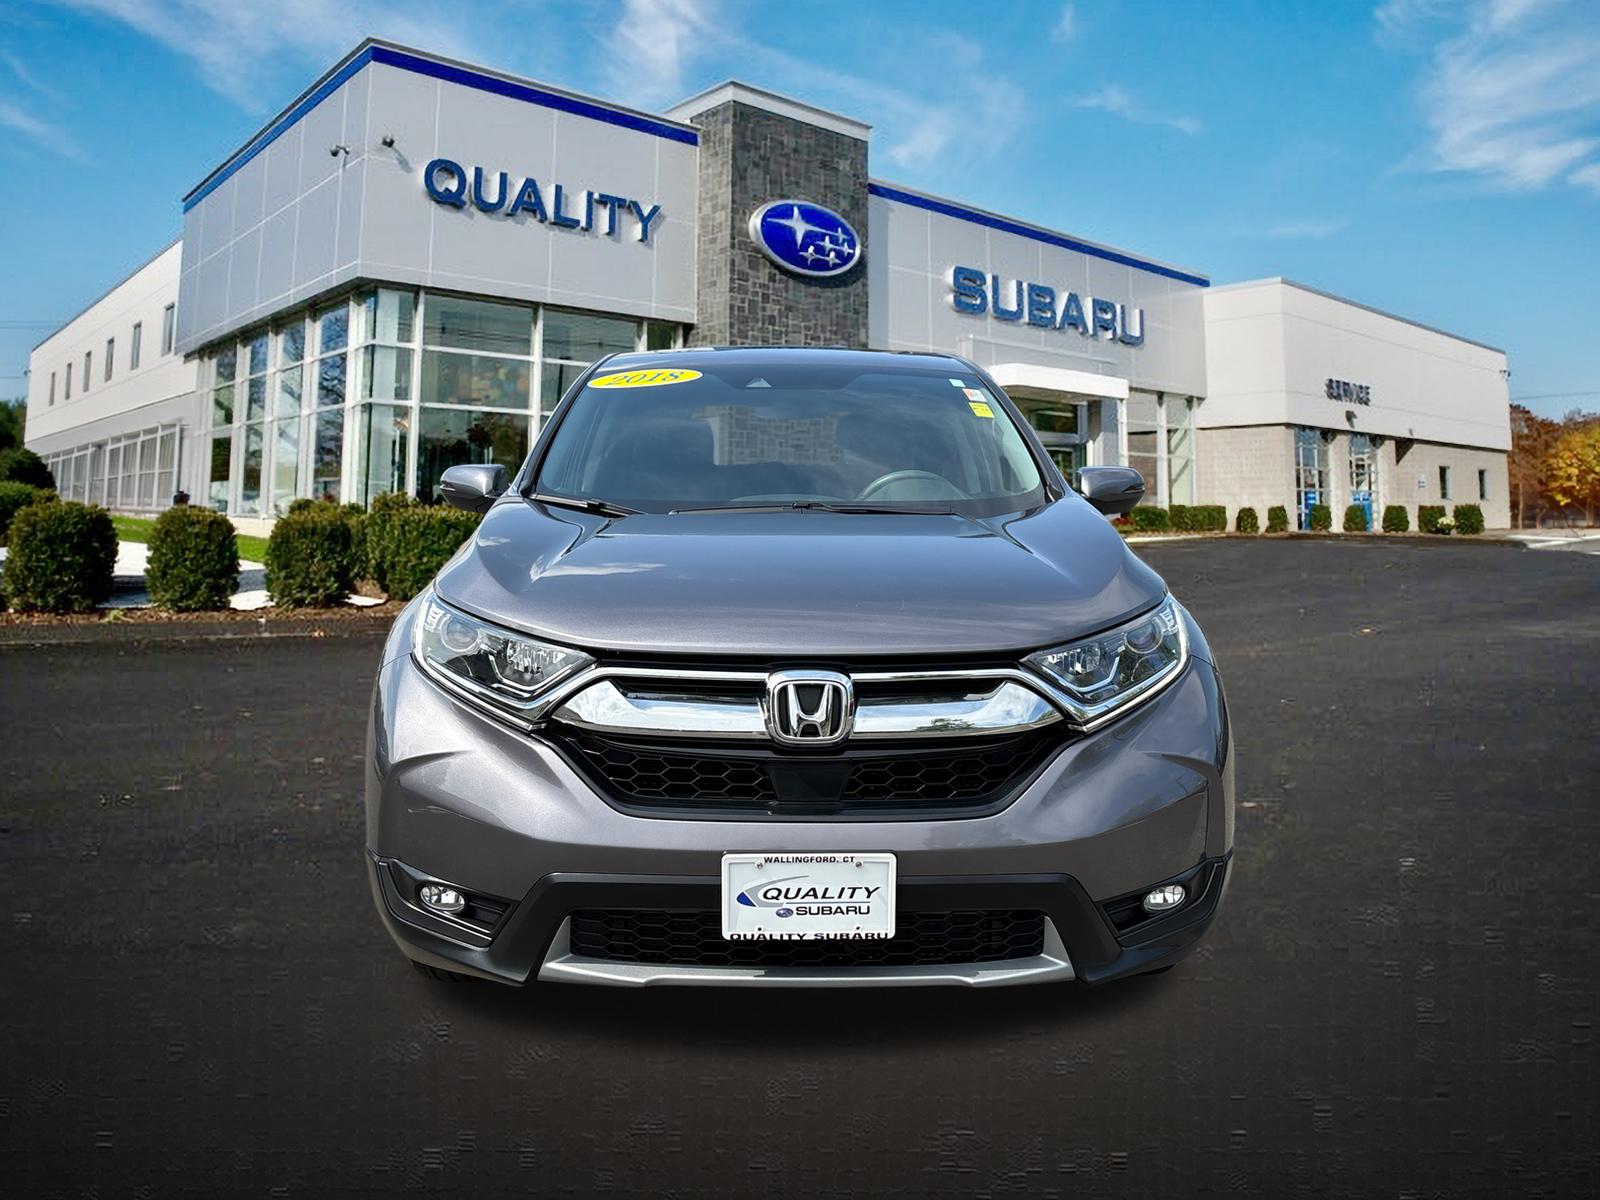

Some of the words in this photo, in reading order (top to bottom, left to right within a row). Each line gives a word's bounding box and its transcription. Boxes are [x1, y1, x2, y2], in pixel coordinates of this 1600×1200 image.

[422, 158, 664, 243] QUALITY
[950, 265, 1145, 346] SUBARU
[604, 371, 685, 386] 2018
[843, 855, 856, 864] CT
[762, 886, 881, 900] QUALITY
[795, 905, 871, 916] SUBARU
[729, 932, 807, 941] QUALITY
[814, 932, 890, 941] SUBARU
